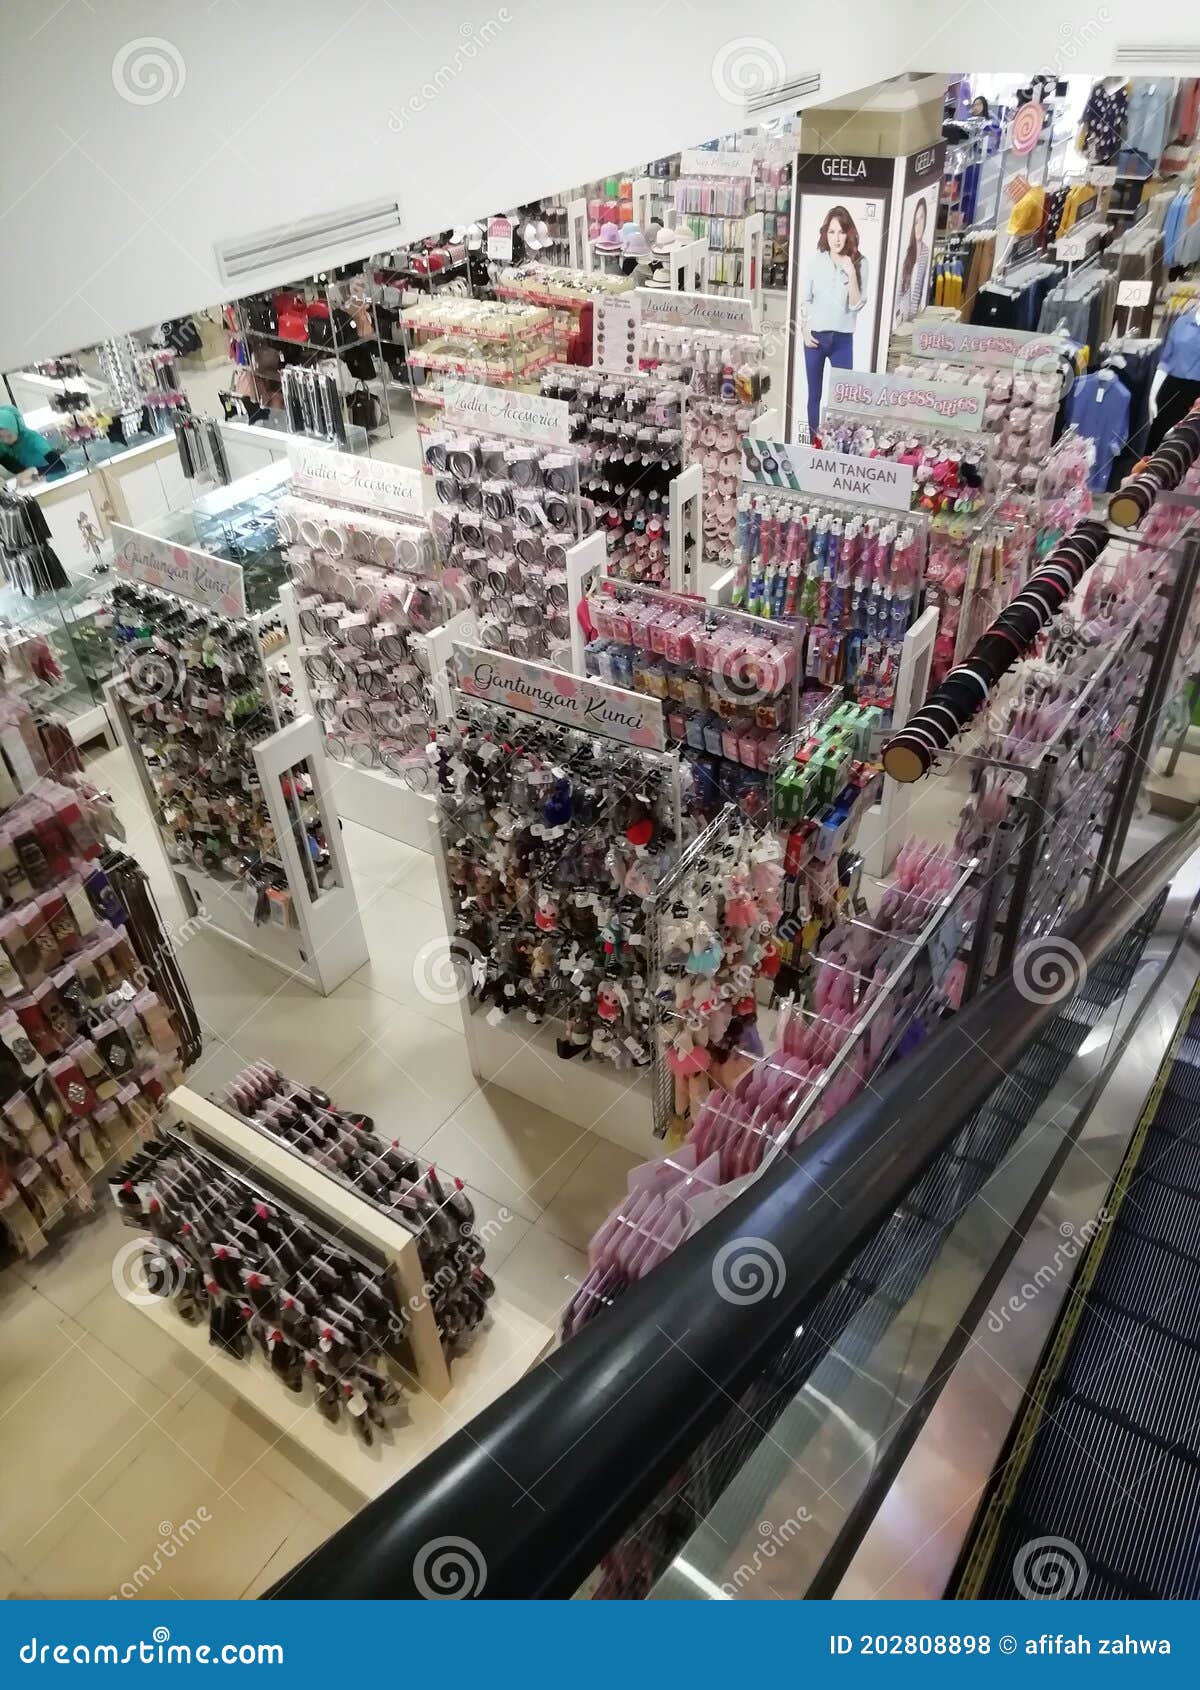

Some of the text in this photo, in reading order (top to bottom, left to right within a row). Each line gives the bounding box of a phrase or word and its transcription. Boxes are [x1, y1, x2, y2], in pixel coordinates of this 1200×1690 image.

[821, 158, 867, 177] GEELA
[1124, 288, 1141, 301] 20
[455, 393, 559, 428] Ladies Accessories
[809, 457, 898, 484] JAM TANGAN
[832, 477, 872, 495] ANAK
[474, 663, 644, 730] Gantungan Kunci
